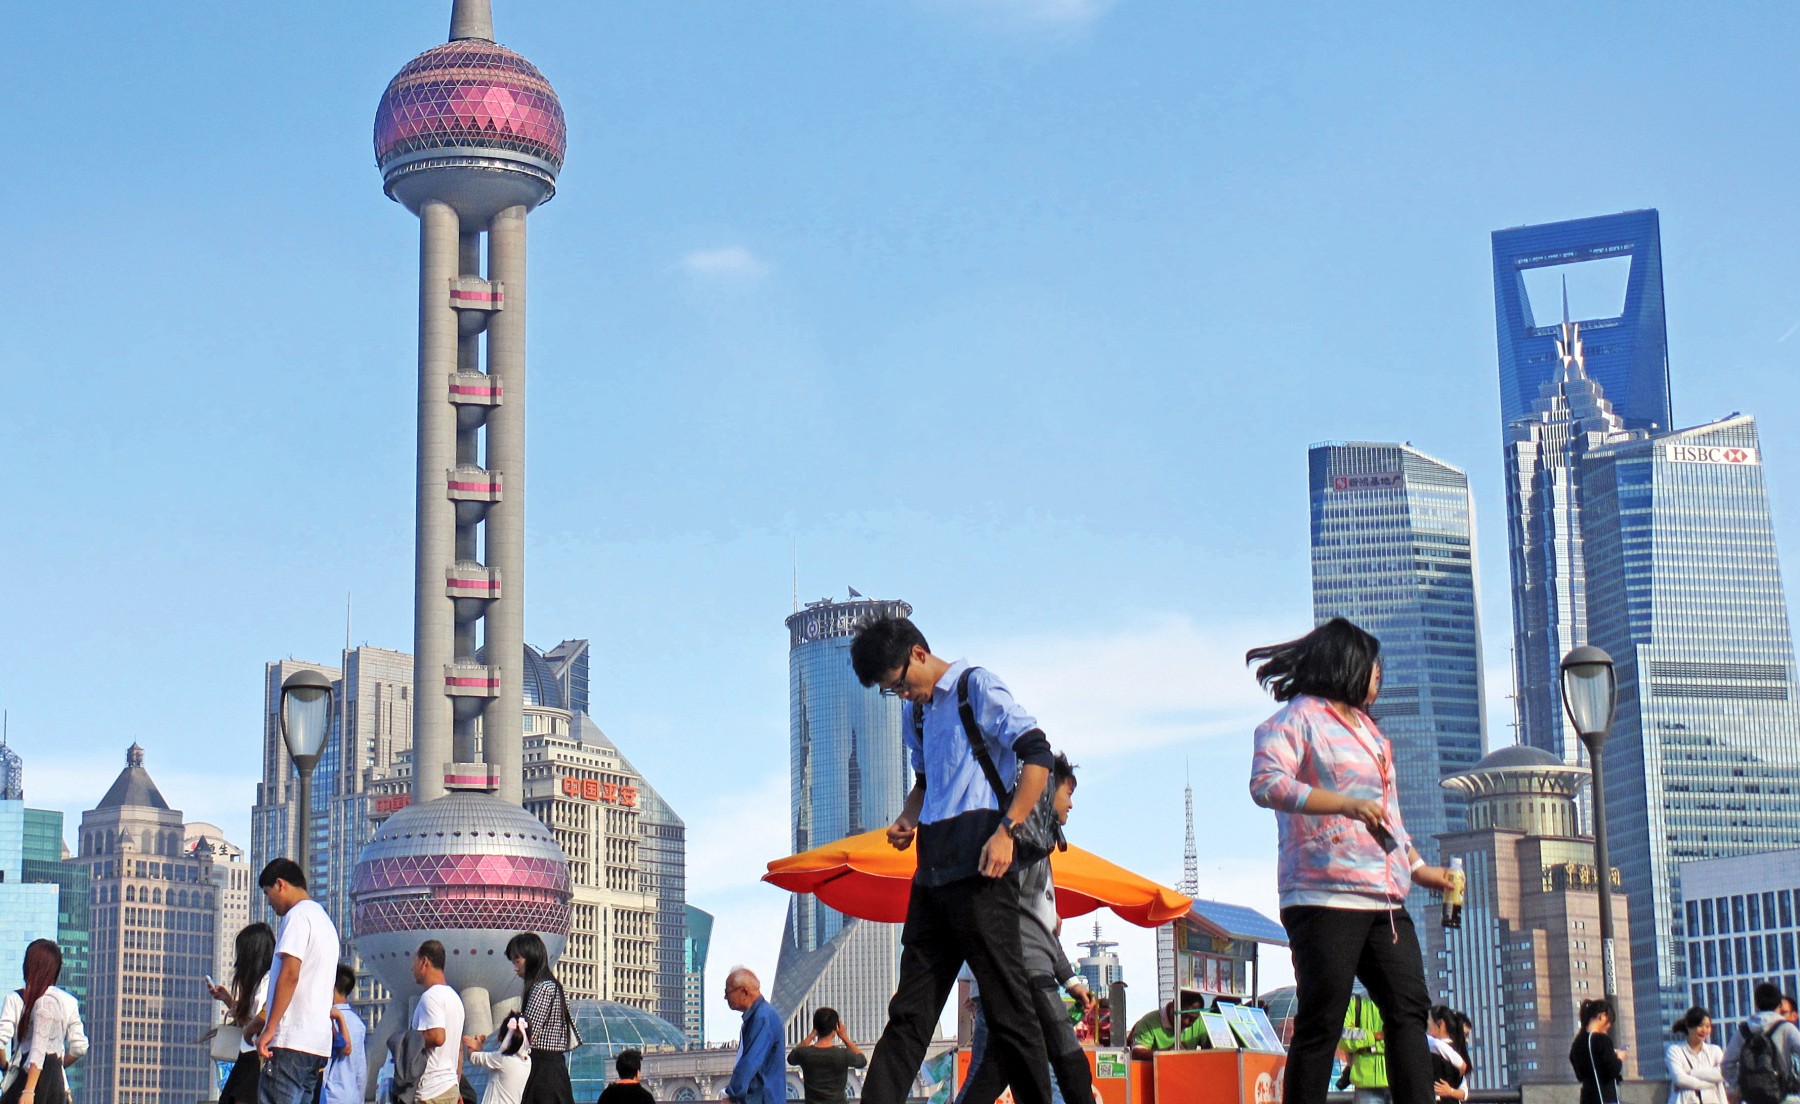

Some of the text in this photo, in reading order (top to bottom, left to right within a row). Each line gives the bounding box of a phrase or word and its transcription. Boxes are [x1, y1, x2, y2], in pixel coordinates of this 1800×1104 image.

[1673, 446, 1721, 463] HSBC
[562, 775, 638, 808] 中国平安
